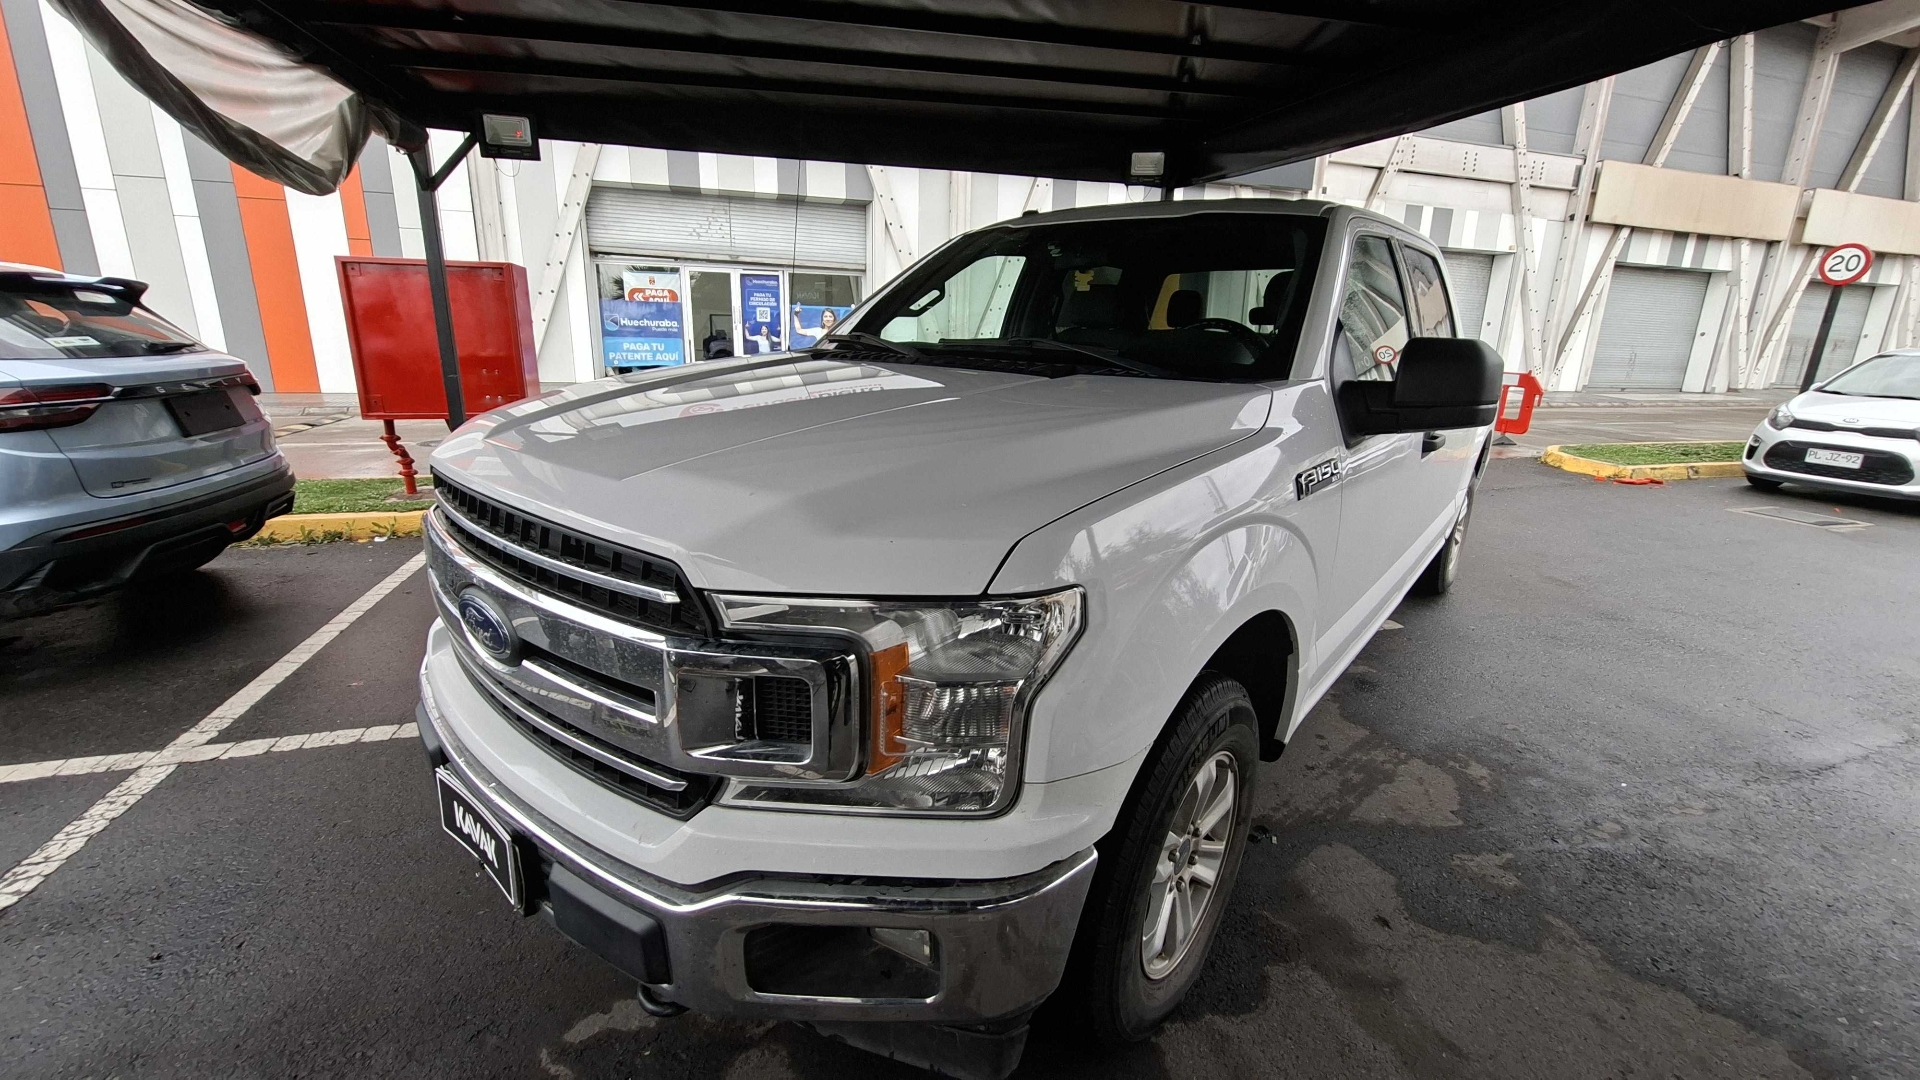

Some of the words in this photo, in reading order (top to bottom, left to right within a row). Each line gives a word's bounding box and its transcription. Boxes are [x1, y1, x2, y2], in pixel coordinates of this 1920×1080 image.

[1827, 254, 1861, 272] 20
[645, 289, 670, 297] PAGA
[623, 343, 650, 351] PAGA
[651, 343, 665, 351] TU
[609, 351, 654, 361] PATENTE
[655, 351, 679, 361] AQUÍ
[155, 376, 242, 394] GEELY
[1808, 450, 1821, 460] PL
[1825, 452, 1860, 465] JZ-92
[465, 606, 496, 648] Ford
[453, 800, 499, 869] KAVAK
